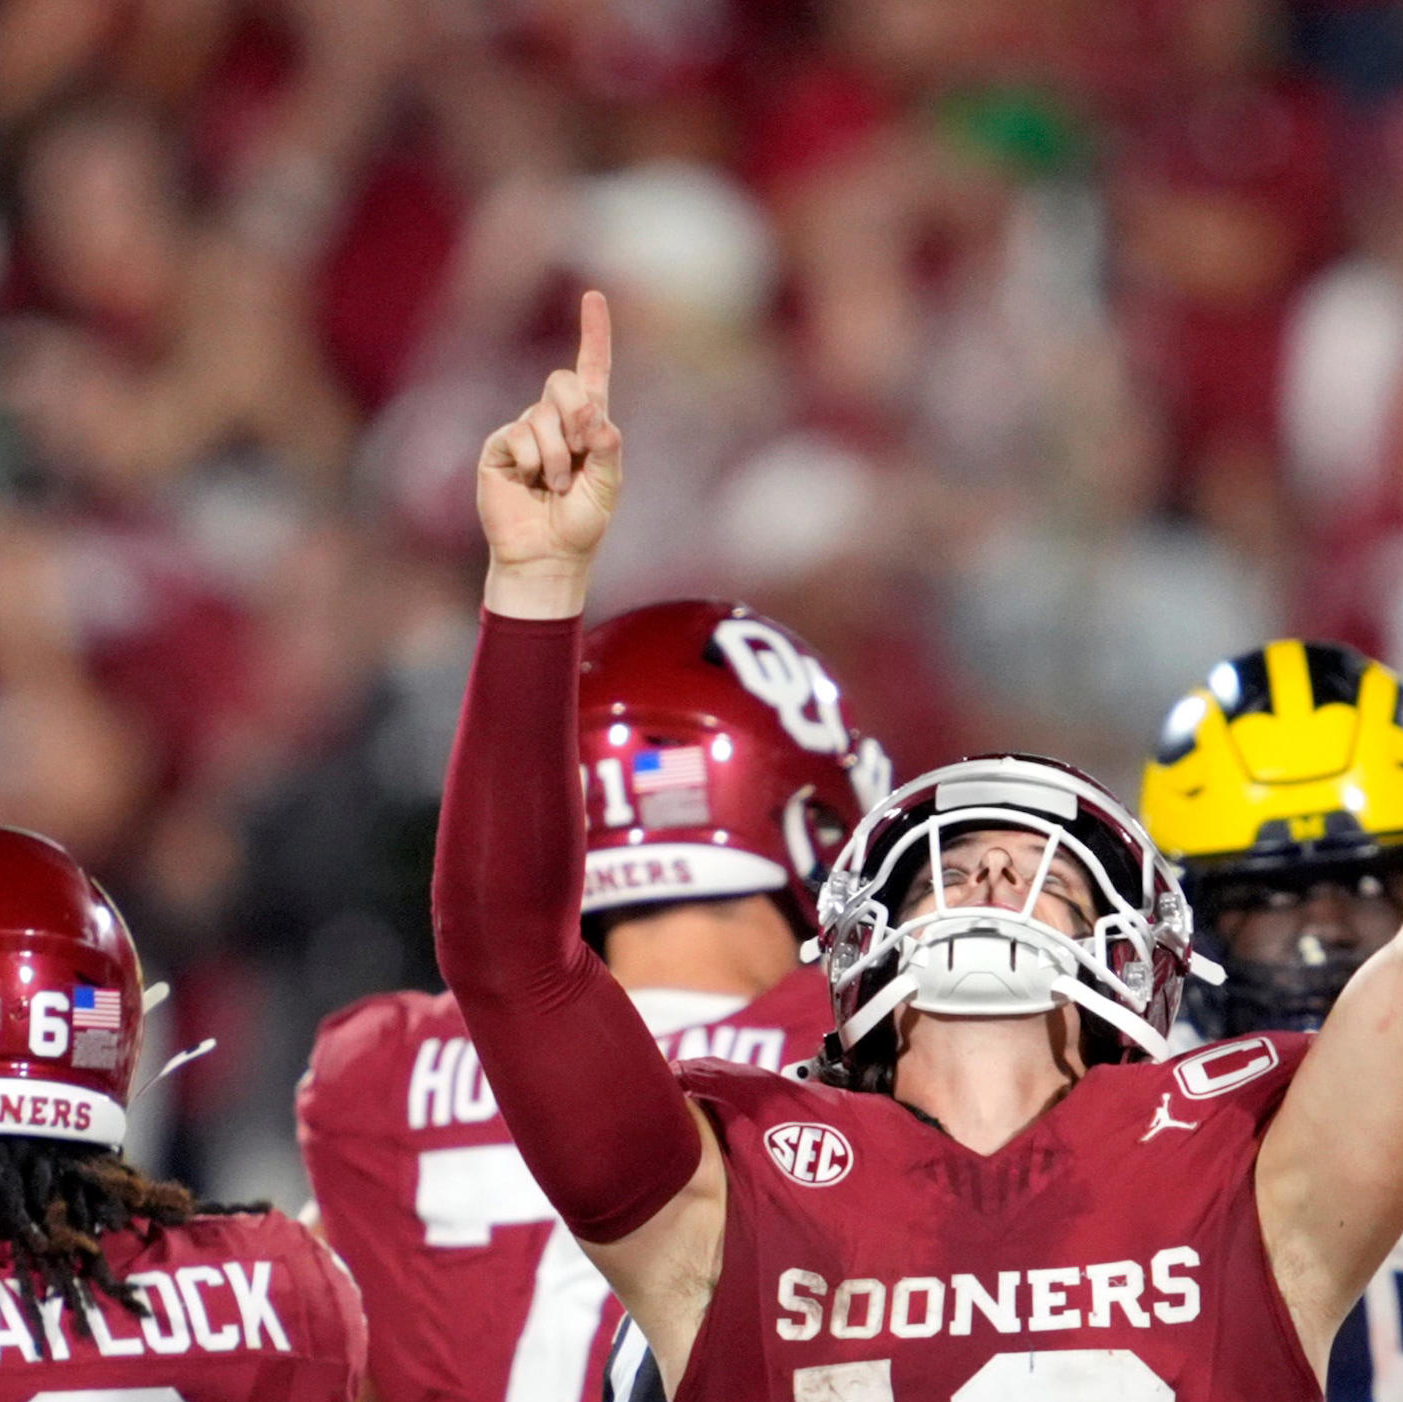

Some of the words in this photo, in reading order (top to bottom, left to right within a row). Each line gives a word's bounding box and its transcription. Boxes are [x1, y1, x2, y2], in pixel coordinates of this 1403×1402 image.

[579, 758, 635, 828] 1
[28, 990, 69, 1058] 6
[769, 1126, 849, 1182] SEC
[776, 1246, 1202, 1342] SOONERS
